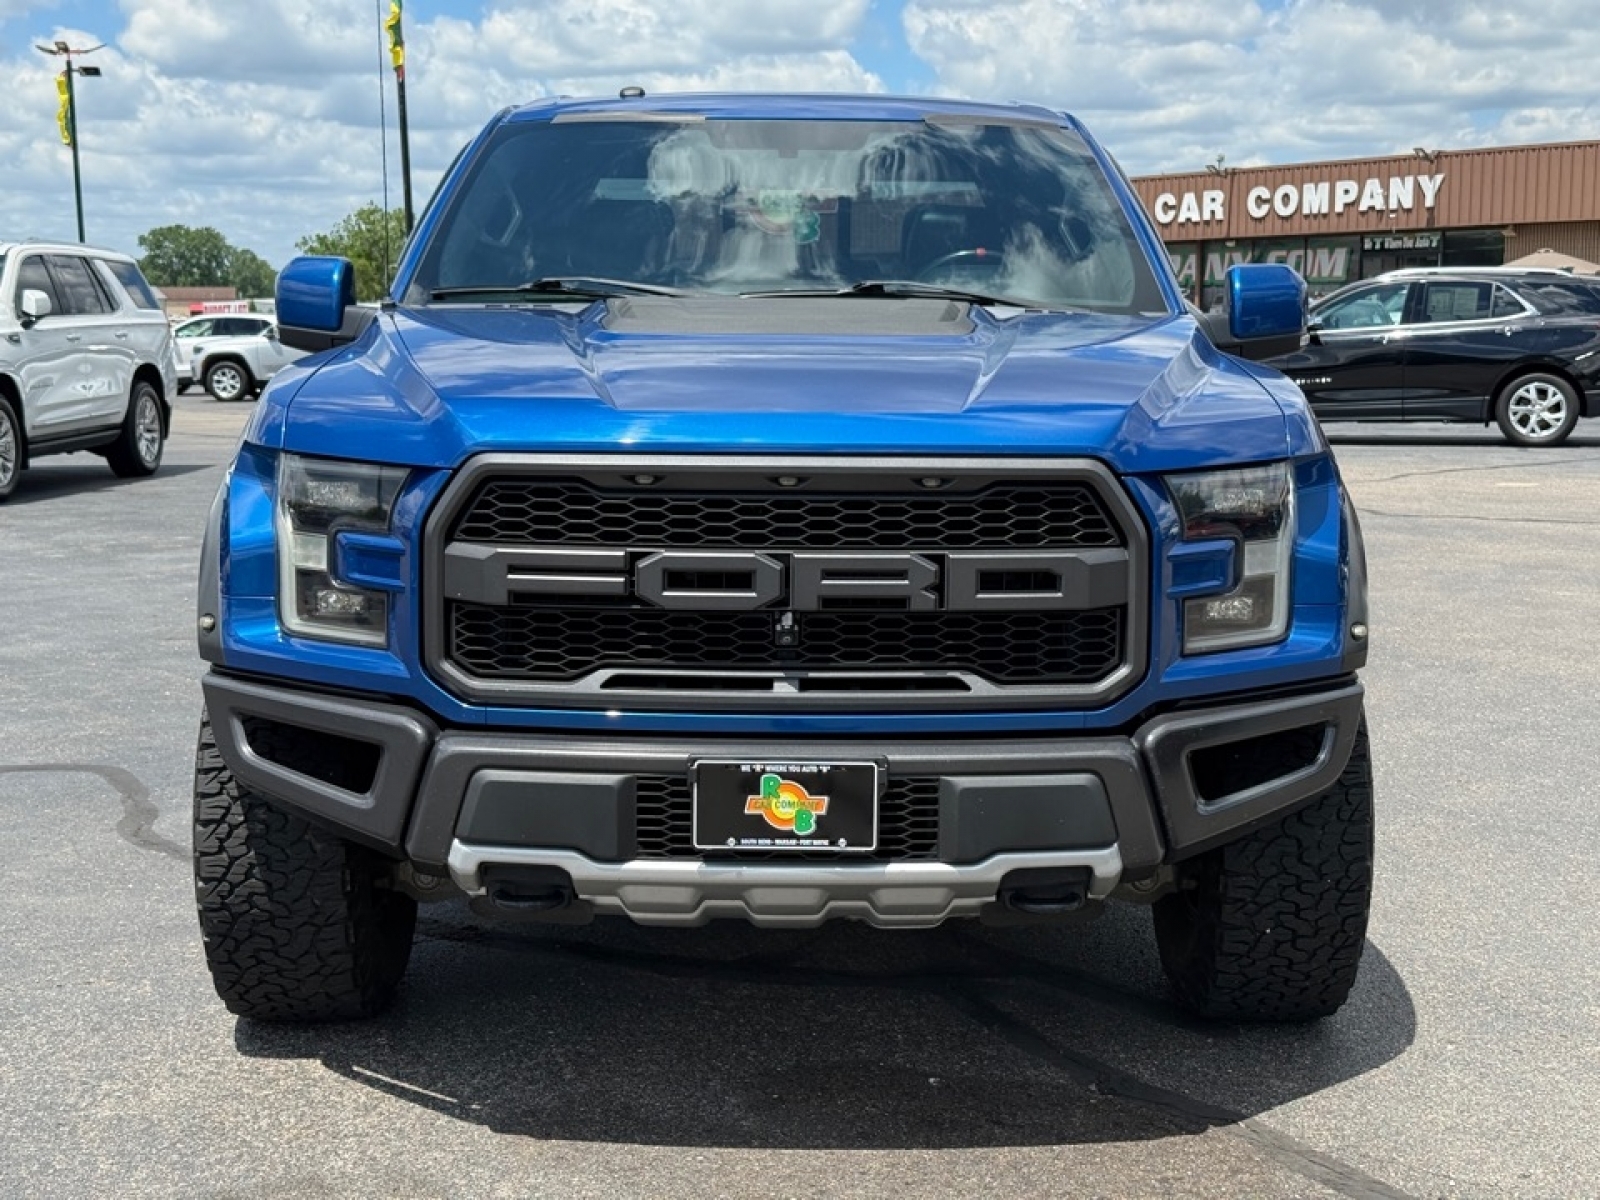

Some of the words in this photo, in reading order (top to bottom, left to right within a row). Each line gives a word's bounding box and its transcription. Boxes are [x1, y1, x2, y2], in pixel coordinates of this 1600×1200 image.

[1154, 190, 1225, 224] CAR
[1246, 174, 1445, 219] COMPANY
[445, 543, 1127, 612] FORD
[761, 773, 782, 799] R
[794, 808, 815, 834] B
